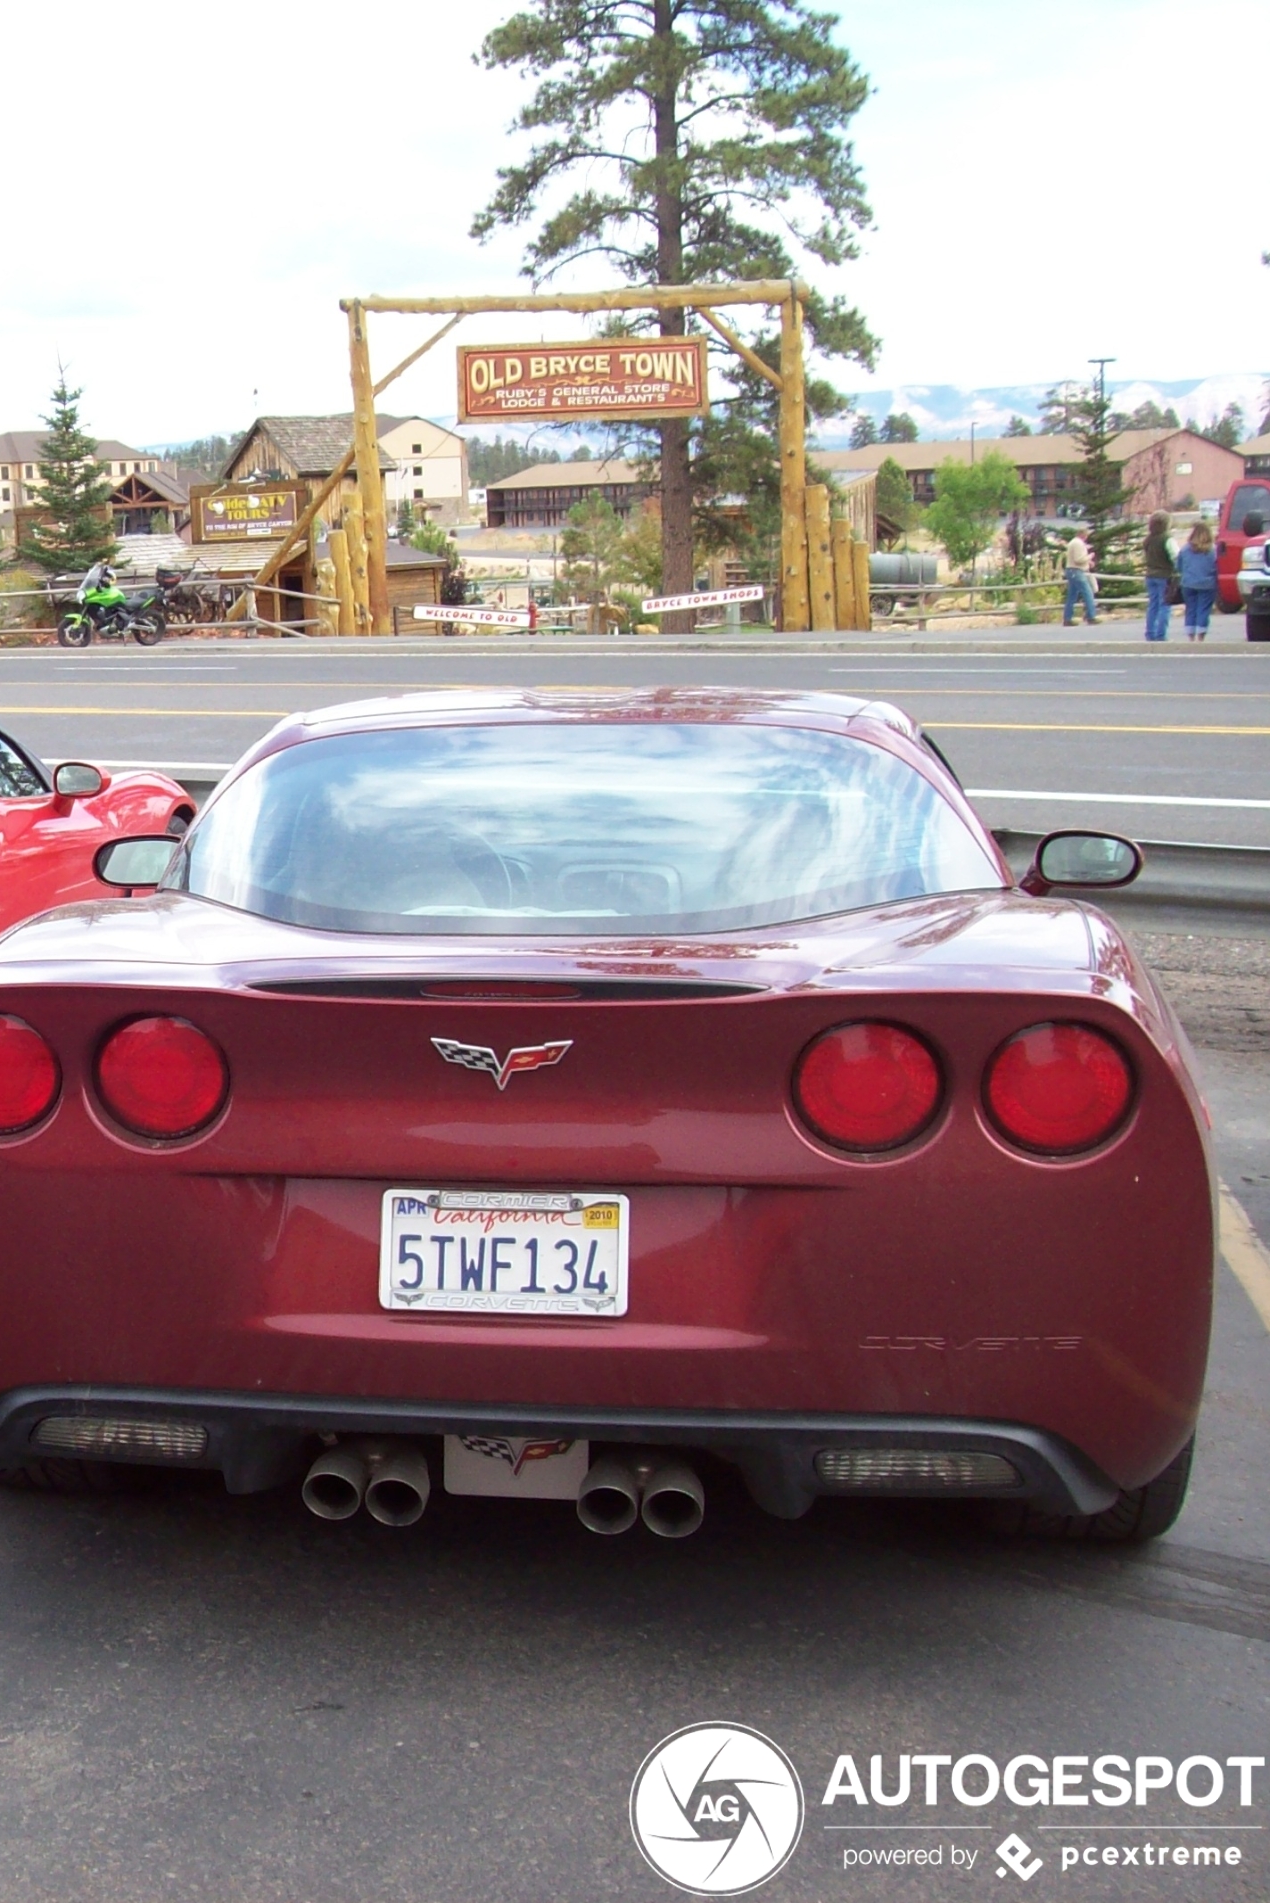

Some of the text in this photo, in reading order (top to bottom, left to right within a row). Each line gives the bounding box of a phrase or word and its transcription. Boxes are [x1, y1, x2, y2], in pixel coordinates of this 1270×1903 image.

[470, 351, 696, 393] OLD BRYCE TOWN
[496, 383, 670, 399] RUBY'S GENERAL STORE
[501, 394, 665, 409] LODGE & RESTAURANT'S
[259, 495, 287, 509] ATV
[226, 509, 270, 520] TOURS
[646, 588, 761, 611] BRYCE TOWN SHOPS
[425, 609, 519, 624] WELCOME TO OLD
[396, 1199, 427, 1215] APR
[589, 1210, 613, 1220] 2010
[434, 1207, 582, 1233] California
[398, 1234, 609, 1294] 5TWF134
[427, 1294, 579, 1312] CORVETTE
[858, 1335, 1083, 1351] CORVETTE
